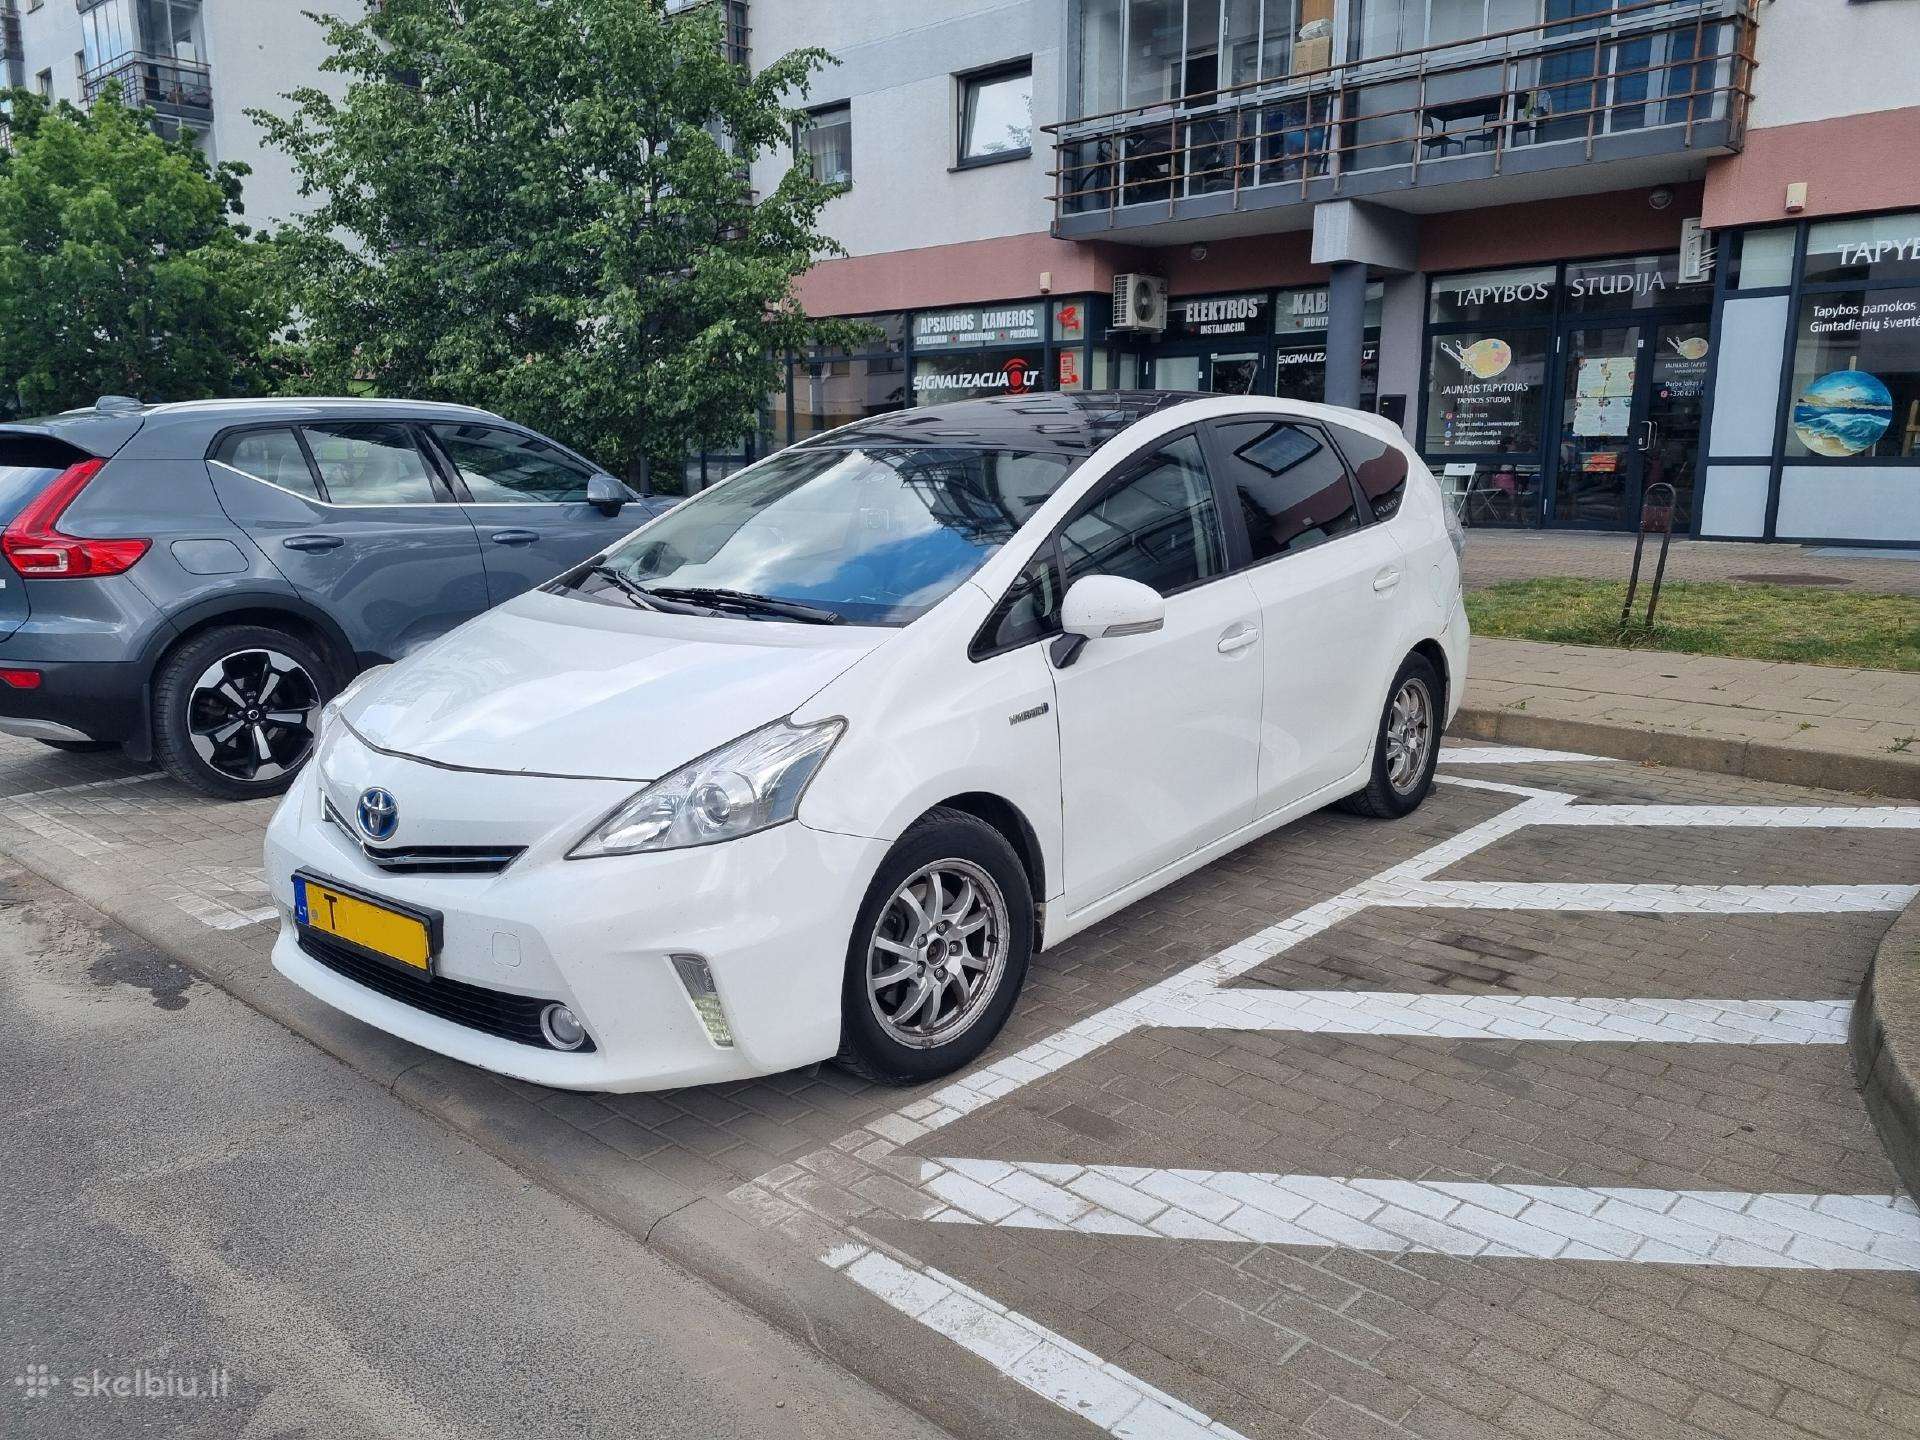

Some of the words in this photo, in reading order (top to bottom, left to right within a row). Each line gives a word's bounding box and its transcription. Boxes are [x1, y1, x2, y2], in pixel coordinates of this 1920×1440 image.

[1454, 280, 1549, 307] TAPYBOS
[1571, 271, 1666, 298] STUDIJA
[1186, 298, 1258, 323] ELEKTROS
[1293, 291, 1329, 315] KAB
[1813, 304, 1859, 319] Tapybos
[1861, 299, 1917, 317] pamokos
[920, 313, 975, 334] APSAUGOS
[982, 309, 1035, 330] KAMEROS
[1809, 318, 1880, 333] Gimtadienių
[1441, 384, 1480, 395] JAUNASIS
[1482, 382, 1529, 393] TAPYTOJAS
